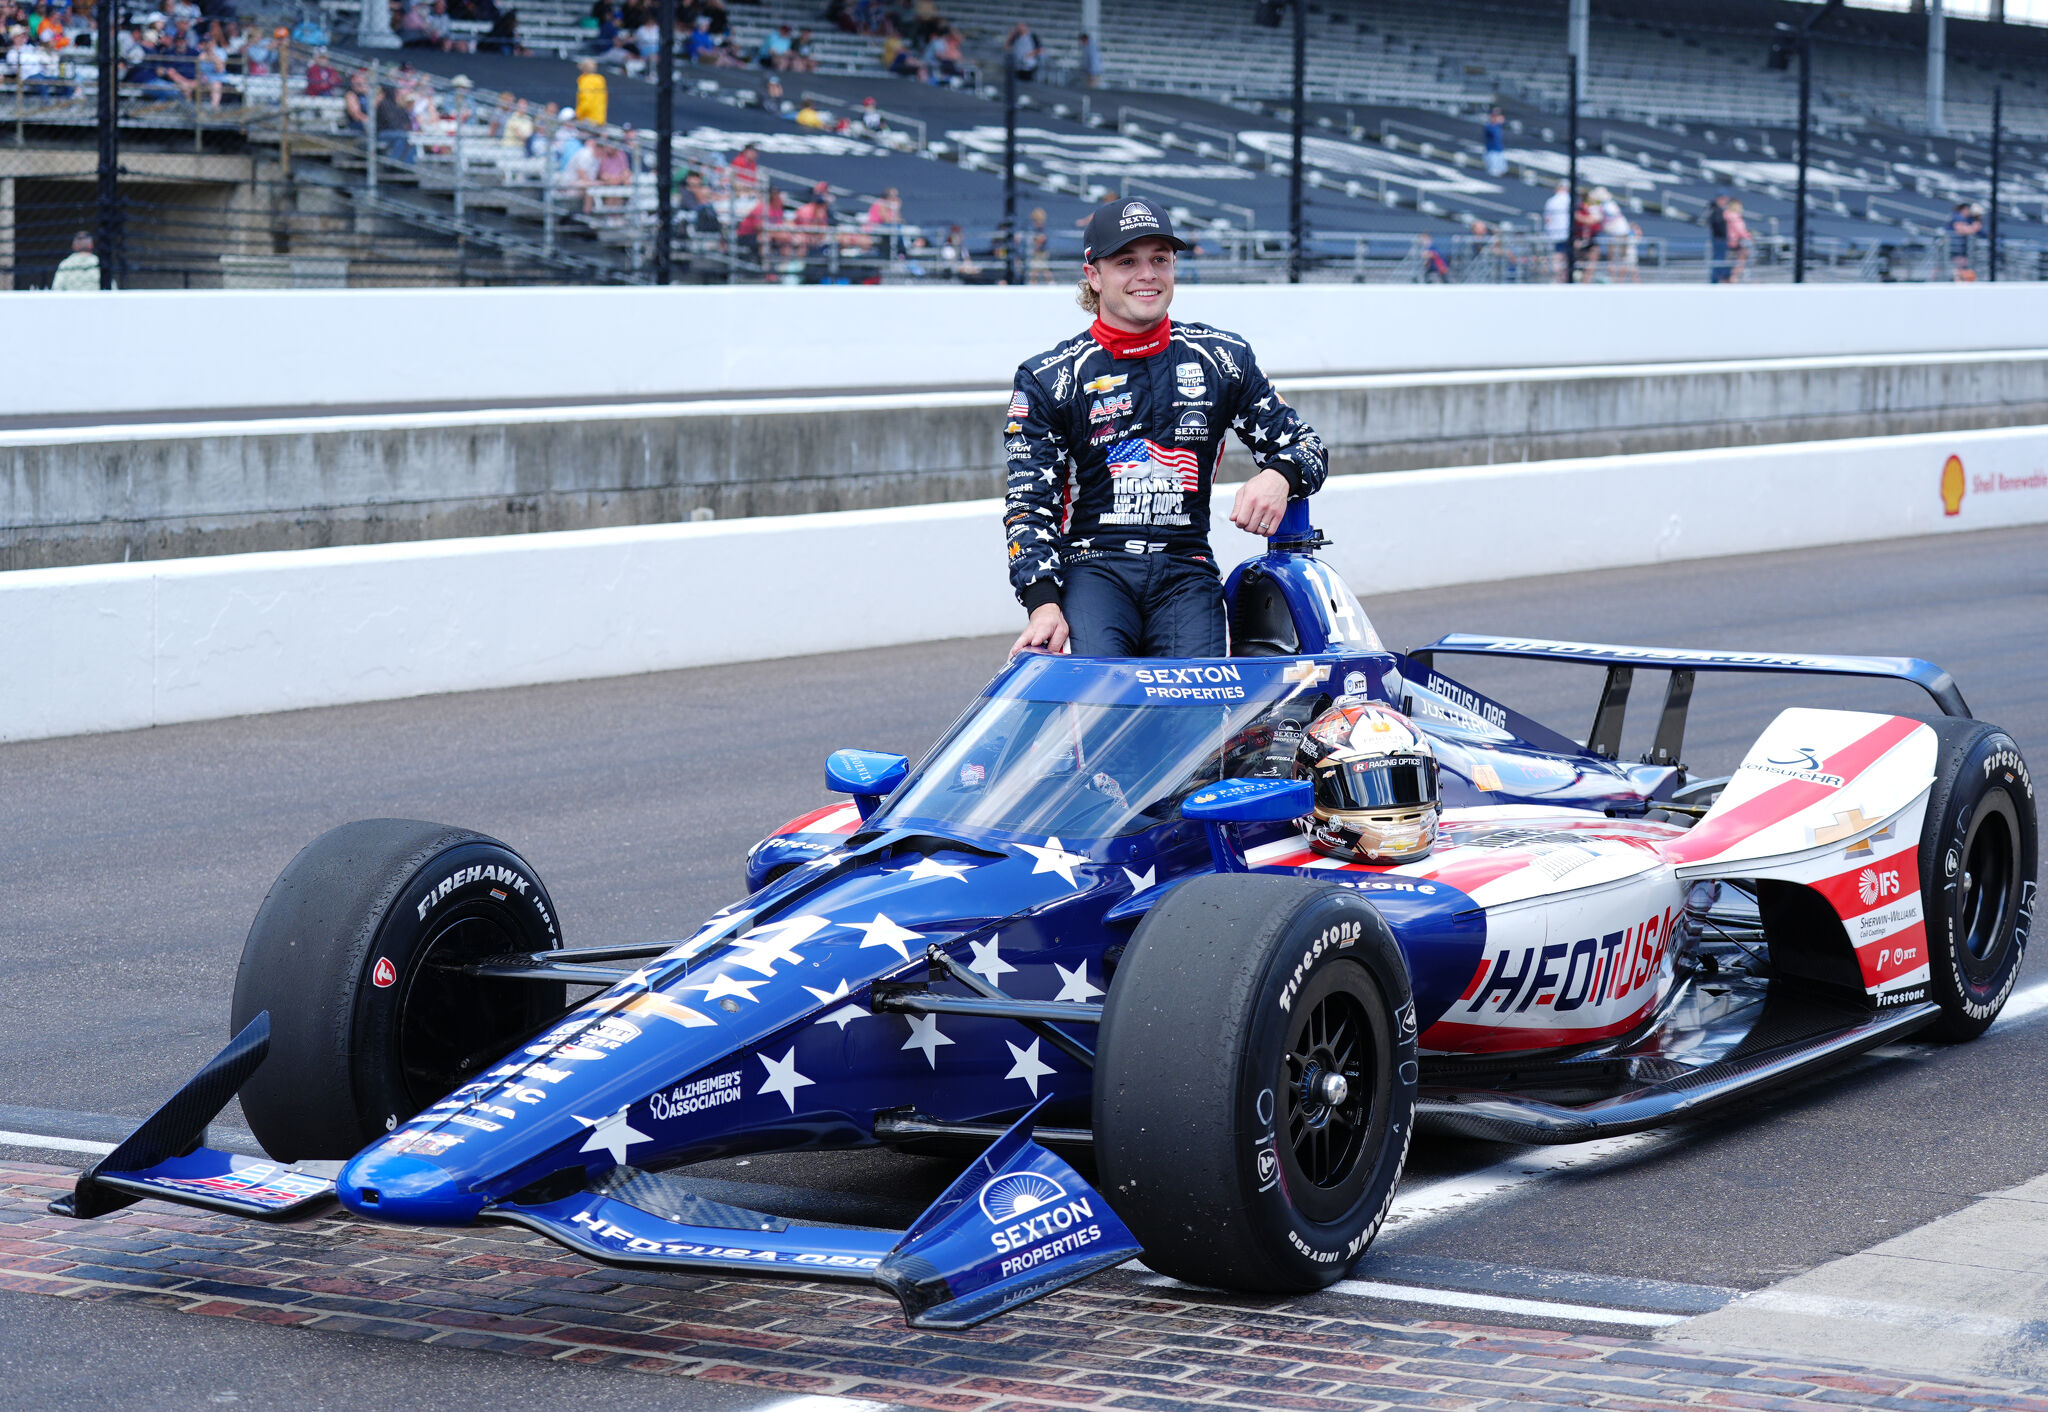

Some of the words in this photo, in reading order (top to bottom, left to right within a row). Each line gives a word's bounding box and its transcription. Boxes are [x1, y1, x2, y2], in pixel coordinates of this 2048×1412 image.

[1119, 215, 1158, 227] SEXTON
[1088, 391, 1133, 420] ABC
[1174, 427, 1209, 436] SEXTON
[1302, 562, 1362, 644] 14
[1135, 664, 1242, 684] SEXTON
[1144, 685, 1246, 700] PROPERTIES
[1368, 758, 1398, 769] RACING
[1398, 757, 1421, 767] OPTICS
[1983, 750, 2033, 799] Firestone
[1879, 869, 1900, 897] IFS
[415, 864, 531, 922] FIREHAWK
[532, 895, 556, 935] INDY
[1278, 919, 1363, 1014] Firestone
[1875, 988, 1925, 1008] Firestone
[668, 1085, 741, 1119] ASSOCIATION
[671, 1070, 742, 1102] ALZHEIMER'S
[990, 1196, 1095, 1255] SEXTON
[1000, 1224, 1102, 1278] PROPERTIES
[1287, 1229, 1312, 1258] 500
[1309, 1250, 1340, 1263] INDY
